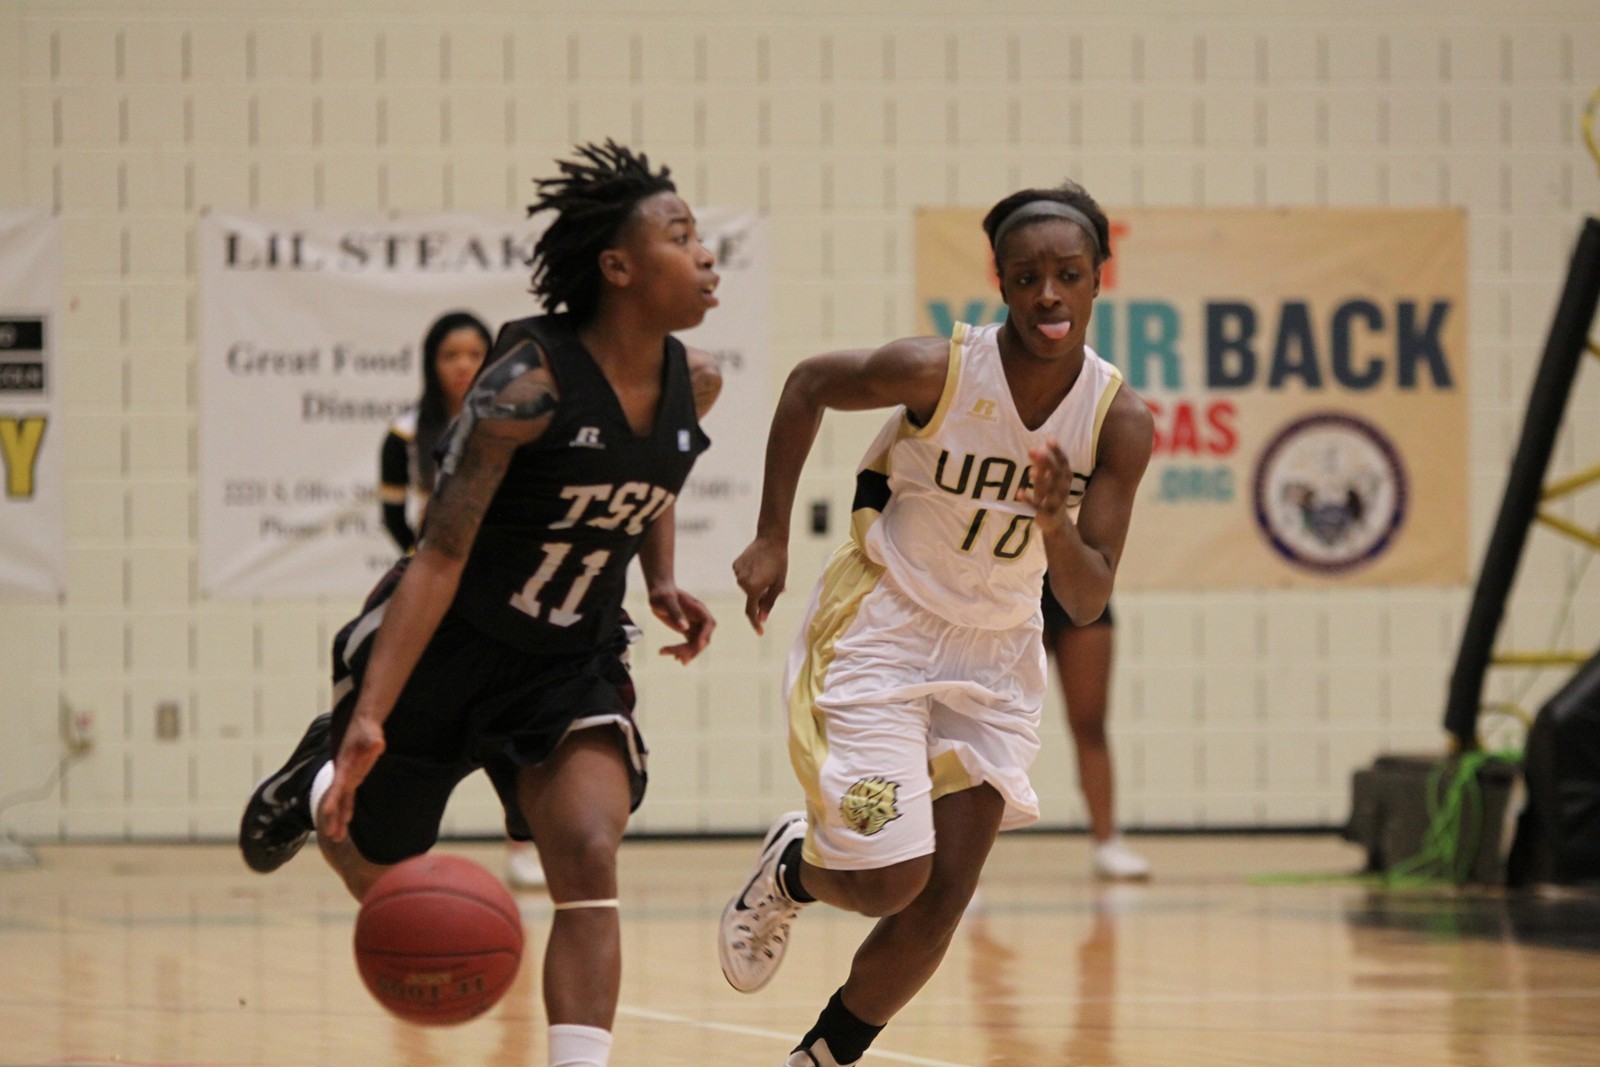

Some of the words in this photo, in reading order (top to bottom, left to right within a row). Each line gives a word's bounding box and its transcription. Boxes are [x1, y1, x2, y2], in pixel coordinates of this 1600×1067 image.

[225, 231, 322, 271] LIL
[226, 343, 320, 376] Great
[331, 345, 412, 374] Food
[928, 301, 1181, 390] YR
[1206, 301, 1454, 389] BACK
[548, 481, 676, 535] TSU
[961, 508, 1034, 559] 10
[509, 542, 611, 627] 11
